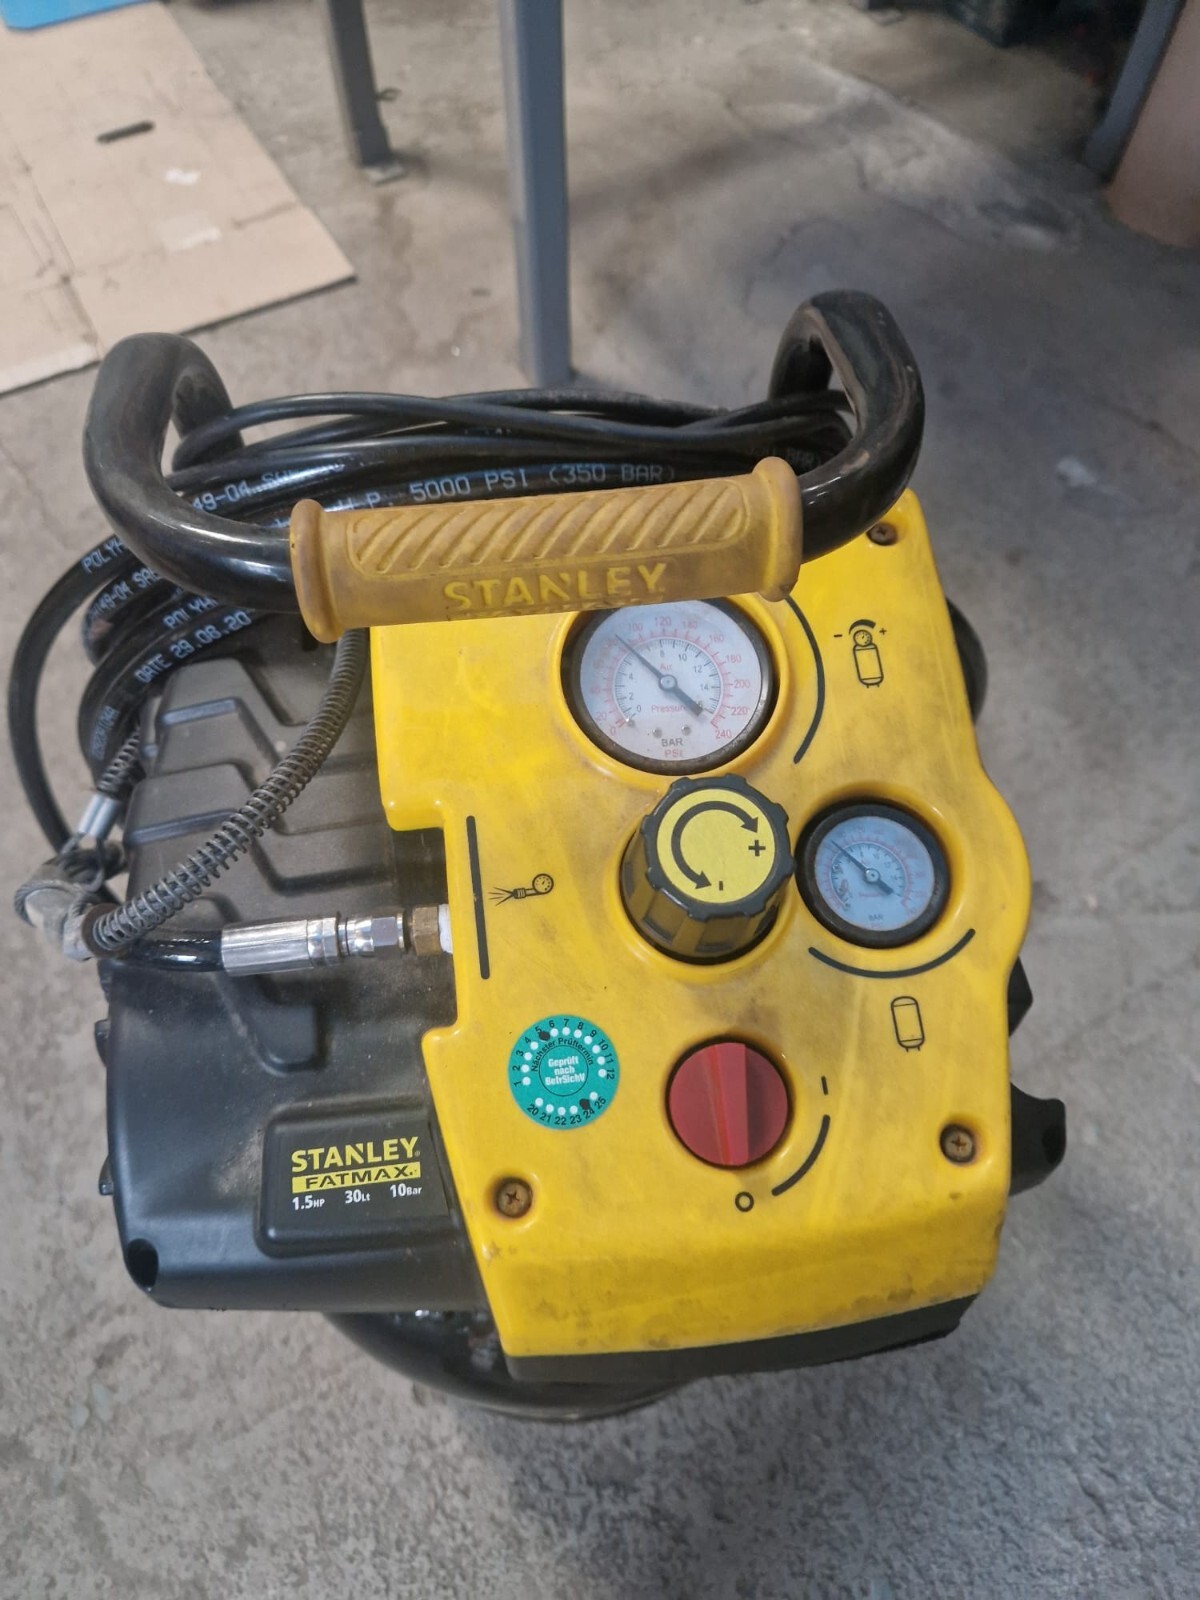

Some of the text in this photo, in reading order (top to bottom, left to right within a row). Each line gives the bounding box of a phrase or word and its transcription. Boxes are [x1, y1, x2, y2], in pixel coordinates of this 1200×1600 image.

[409, 476, 471, 502] 5000
[485, 469, 530, 492] PSI
[549, 463, 606, 485] (350
[621, 463, 675, 482] BAR)
[444, 562, 667, 610] STANLEY
[654, 616, 672, 627] 120
[134, 609, 252, 684] DATE 29.08.20
[678, 653, 688, 662] 10
[693, 665, 703, 674] 12
[700, 683, 709, 691] 14
[734, 679, 751, 689] 200
[731, 705, 749, 716] 220
[715, 729, 733, 740] 240
[661, 737, 684, 748] BAR
[548, 1020, 555, 1028] 6
[563, 1018, 570, 1027] 7
[577, 1021, 584, 1030] 8
[590, 1029, 597, 1038] 9
[524, 1036, 532, 1044] 4
[598, 1038, 609, 1051] 10
[515, 1050, 524, 1058] 3
[531, 1037, 594, 1072] Nächster Prüftermin
[604, 1053, 614, 1064] 11
[548, 1056, 579, 1068] Geprüft
[554, 1066, 575, 1076] nach
[606, 1068, 615, 1080] 12
[593, 1096, 607, 1109] 25
[527, 1104, 539, 1116] 20
[540, 1113, 552, 1124] 21
[554, 1116, 567, 1126] 22
[569, 1114, 582, 1125] 23
[291, 1136, 418, 1173] STANLEY
[292, 1183, 423, 1211] 1.5HP 30Lt 10Bar
